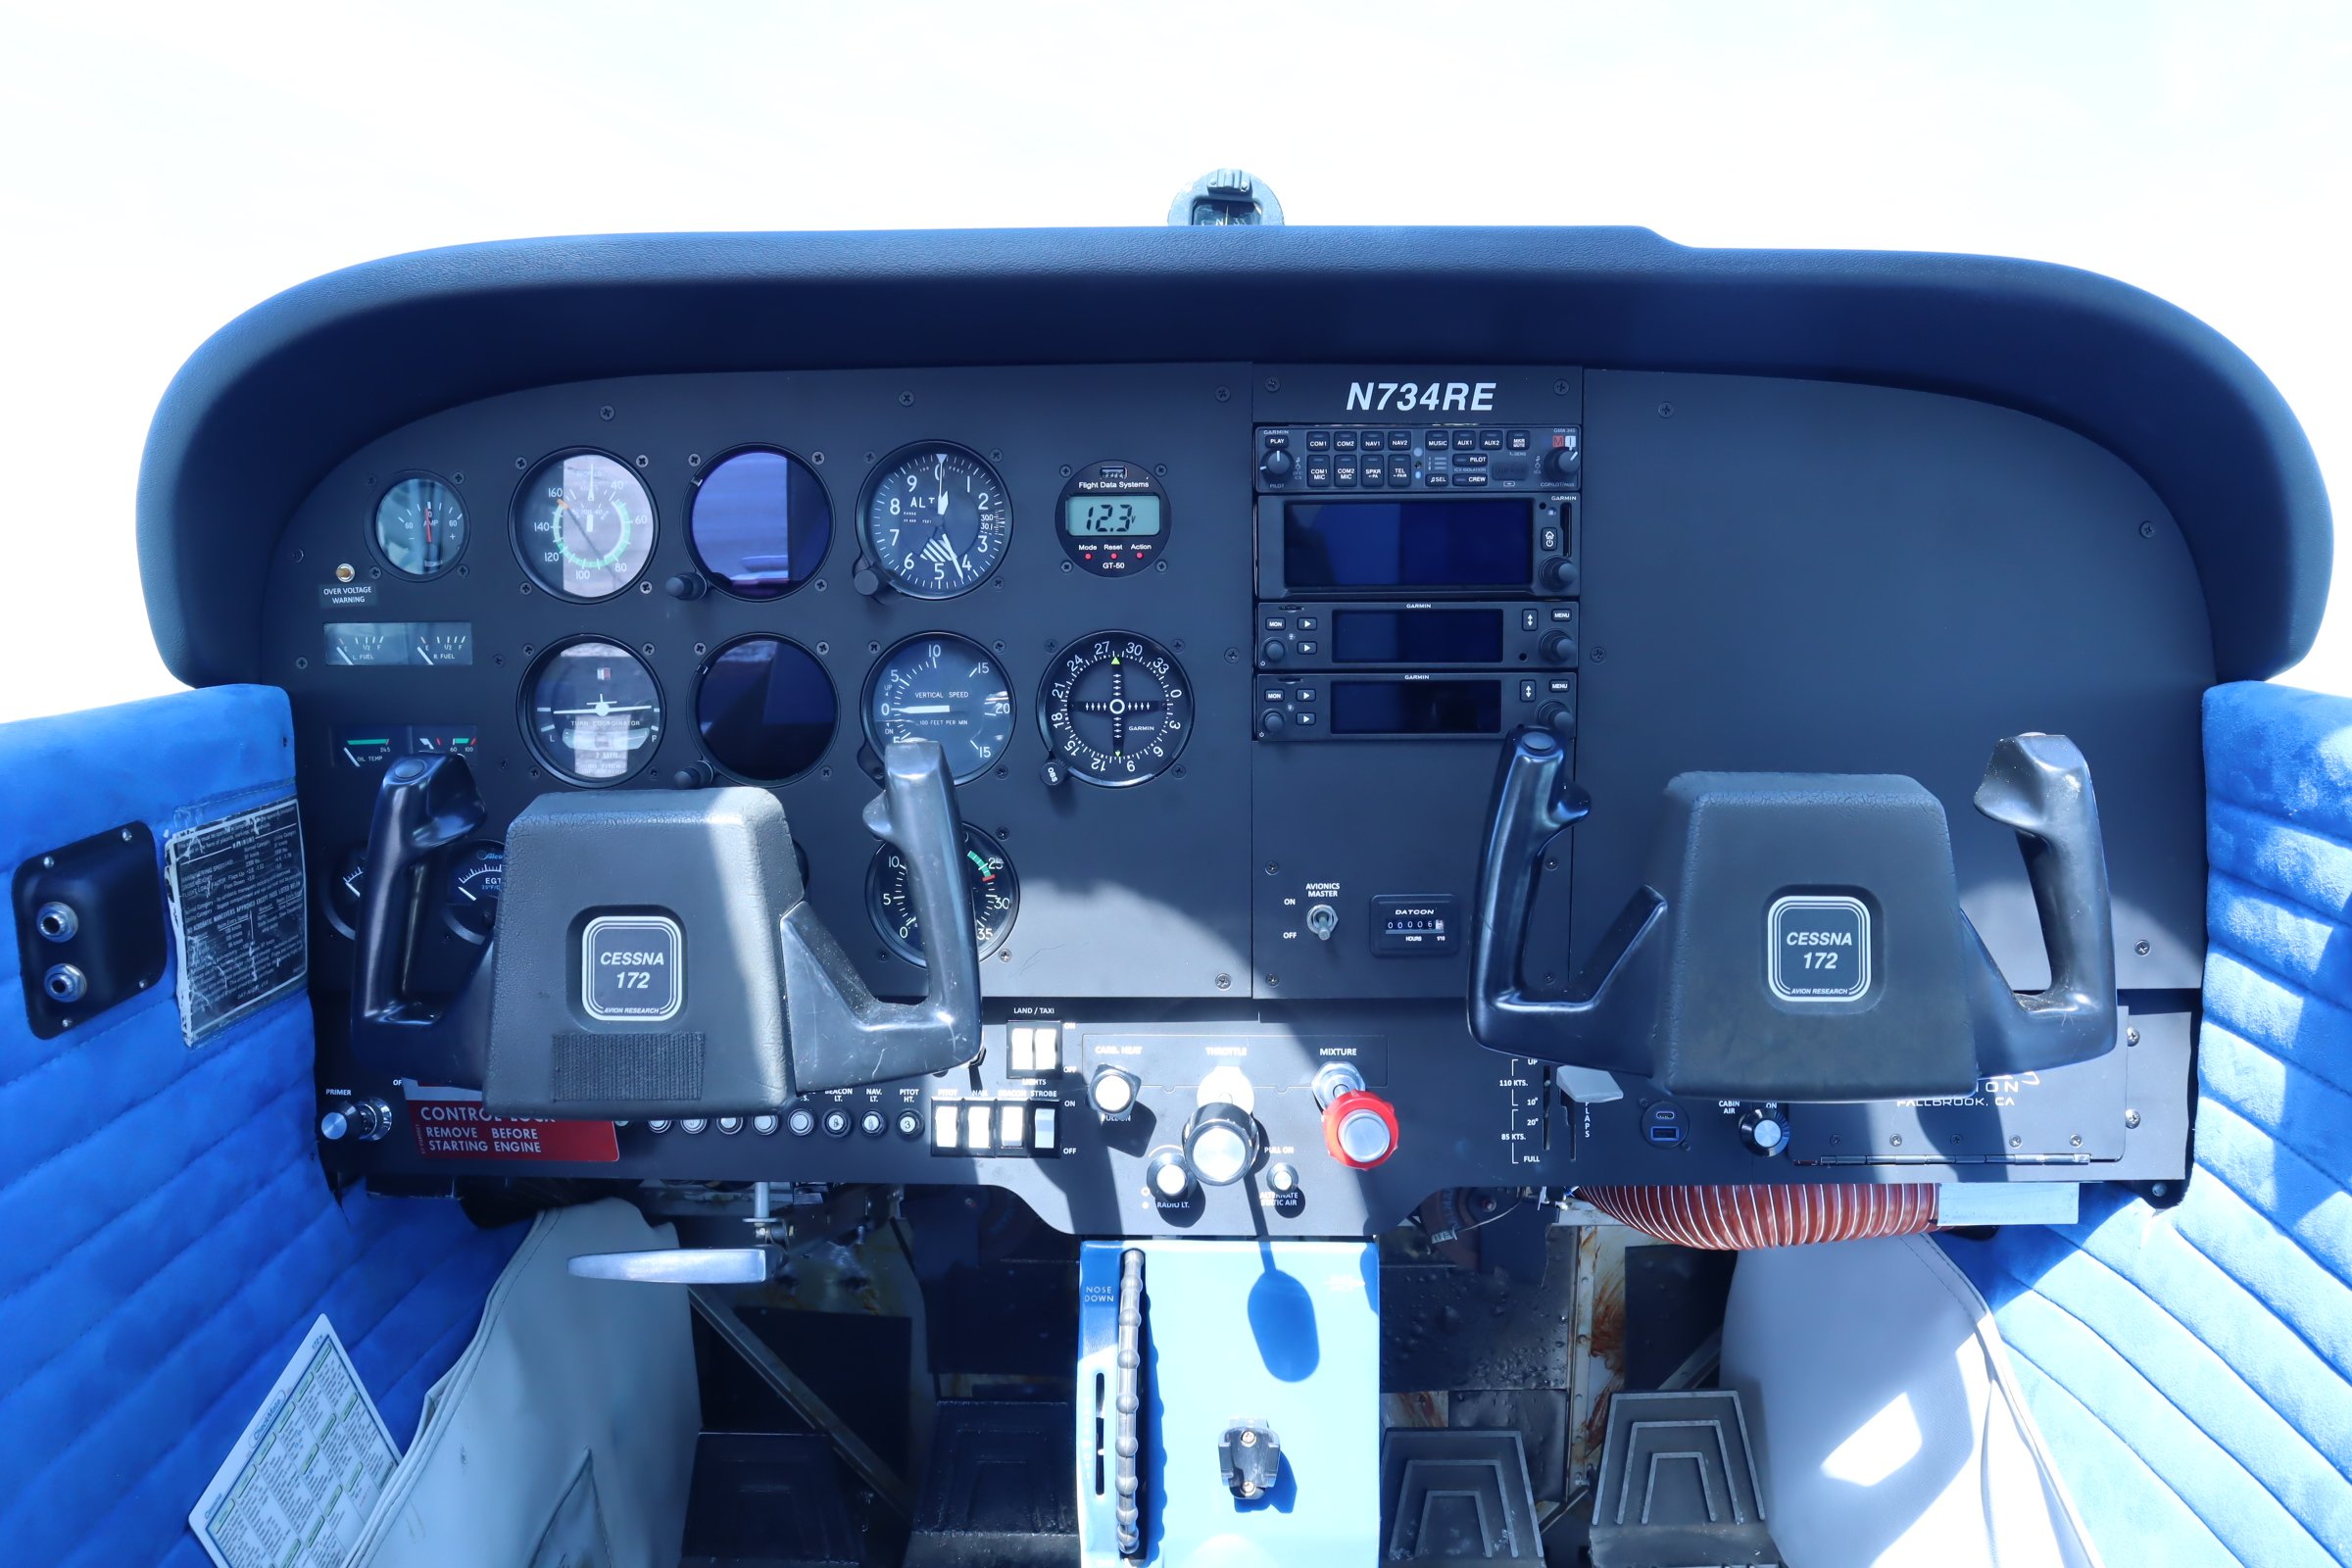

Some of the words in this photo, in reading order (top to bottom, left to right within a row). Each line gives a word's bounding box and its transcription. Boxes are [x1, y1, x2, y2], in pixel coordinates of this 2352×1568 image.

[1346, 382, 1496, 411] N734RE
[611, 481, 624, 489] 40
[907, 475, 917, 492] 9
[548, 488, 563, 497] 160
[890, 498, 900, 515] 8
[910, 496, 935, 508] ALT
[978, 493, 988, 510] 2
[1086, 504, 1132, 532] 12.3
[534, 523, 549, 531] 140
[889, 529, 899, 546] 7
[978, 535, 987, 552] 3
[544, 553, 559, 562] 120
[904, 552, 914, 569] 6
[962, 554, 972, 570] 4
[615, 564, 627, 572] 80
[934, 563, 944, 580] 5
[576, 571, 590, 579] 100
[929, 644, 941, 657] 10
[1094, 641, 1110, 654] 27
[1126, 642, 1142, 656] 30
[978, 662, 989, 673] 15
[1067, 654, 1083, 672] 24
[1153, 657, 1169, 674] 33
[891, 670, 899, 682] 5
[1052, 682, 1066, 698] 21
[1171, 689, 1182, 698] 0
[881, 703, 889, 716] 0
[995, 703, 1010, 714] 20
[1051, 712, 1064, 729] 18
[1169, 720, 1181, 730] 3
[980, 746, 991, 758] 15
[1064, 740, 1080, 757] 15
[1153, 746, 1164, 757] 6
[1091, 758, 1106, 772] 12
[1127, 760, 1135, 772] 9
[1048, 767, 1058, 782] OBS
[888, 856, 900, 867] 10
[988, 857, 1003, 869] 25
[883, 894, 891, 905] 5
[994, 897, 1010, 909] 30
[899, 927, 908, 938] 0
[977, 928, 993, 940] 35
[1786, 932, 1852, 946] CESSNA
[600, 952, 664, 965] CESSNA
[1803, 952, 1838, 969] 172
[617, 972, 650, 988] 172
[1121, 1046, 1142, 1054] HEAT
[1206, 1047, 1247, 1056] THROTTLE
[1319, 1048, 1357, 1056] MIXTURE
[1527, 1097, 1538, 1105] 10°
[1995, 1097, 2015, 1106] CA
[421, 1107, 502, 1122] CONTRO
[426, 1127, 478, 1138] REMOVE
[492, 1128, 538, 1139] BEFORE
[429, 1140, 488, 1152] STARTING
[494, 1142, 541, 1153] ENGINE
[254, 1398, 281, 1441] CheckMate
